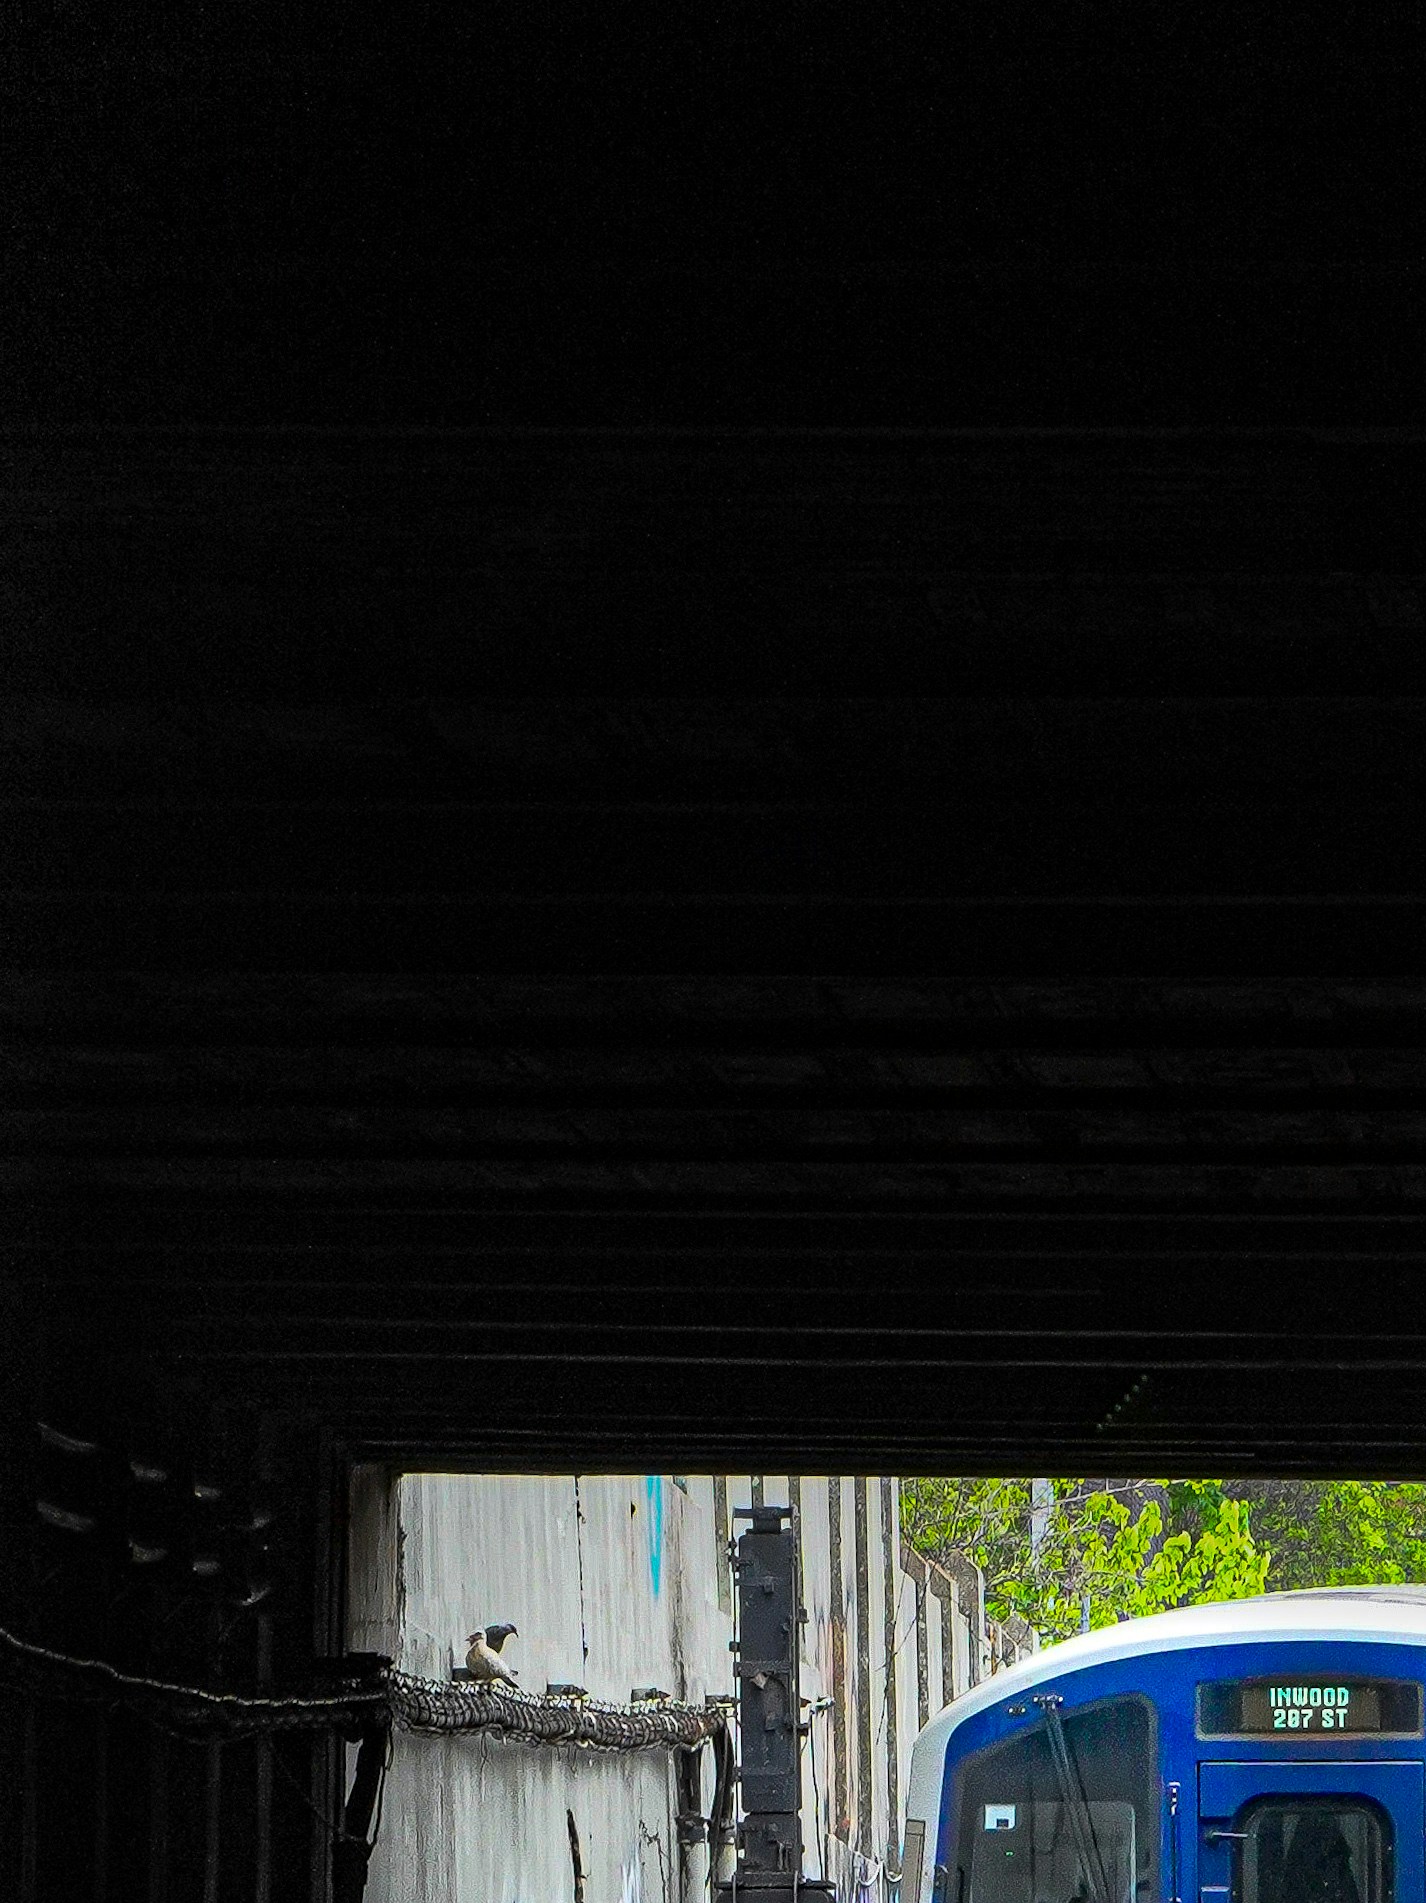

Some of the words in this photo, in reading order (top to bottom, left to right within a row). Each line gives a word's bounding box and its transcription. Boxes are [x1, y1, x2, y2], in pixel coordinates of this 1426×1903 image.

[1270, 1688, 1350, 1708] INWOOD
[1273, 1708, 1313, 1729] 207
[1321, 1708, 1349, 1729] ST
